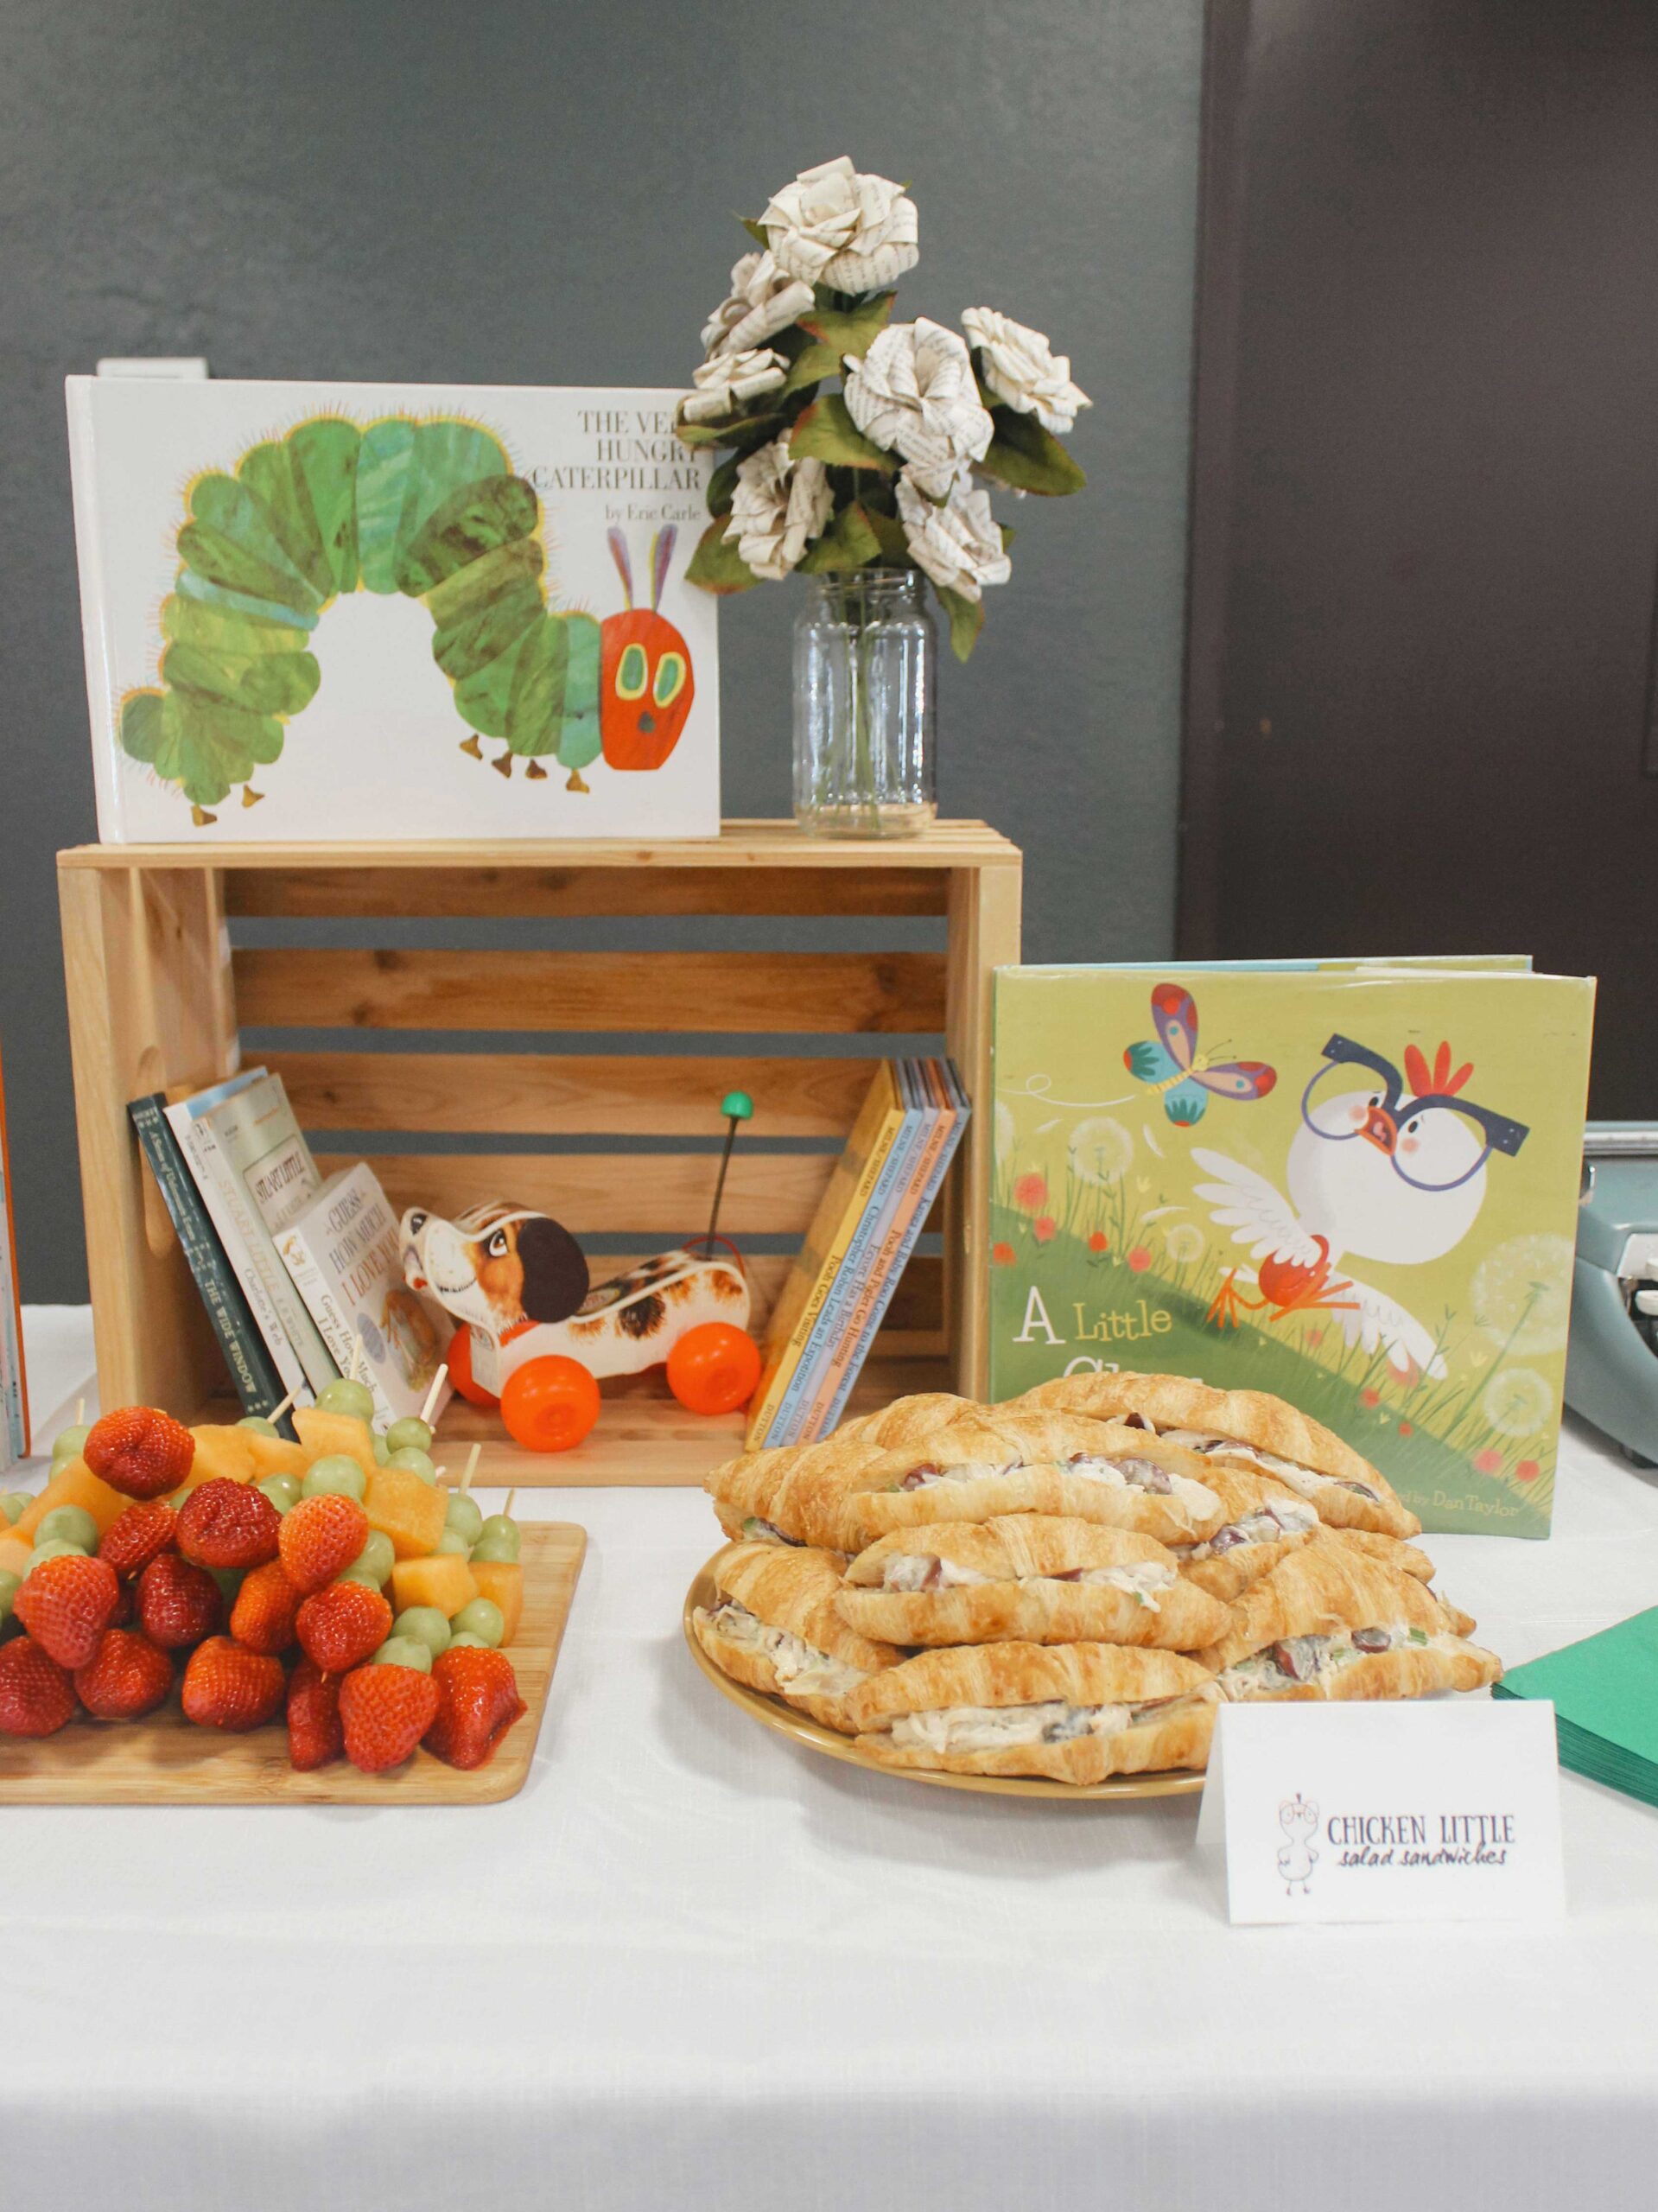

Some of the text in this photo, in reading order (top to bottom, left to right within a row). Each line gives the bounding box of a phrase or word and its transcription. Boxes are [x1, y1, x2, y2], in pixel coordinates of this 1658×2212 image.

[578, 410, 677, 434] THE VE
[532, 466, 702, 490] CATERPILLAR
[606, 504, 701, 524] by Eric Carle
[255, 1151, 306, 1205] STUART LITTLE
[910, 1196, 931, 1228] Kanga
[218, 1179, 256, 1239] STUART
[247, 1242, 280, 1294] LITTLE
[328, 1202, 387, 1274] HOW MUCH
[848, 1205, 880, 1263] Christopher
[882, 1230, 903, 1256] Pooh
[901, 1230, 914, 1249] and
[823, 1255, 842, 1281] Pooh
[857, 1244, 881, 1277] Eeyore
[873, 1258, 886, 1278] and
[891, 1249, 908, 1274] Baby
[341, 1281, 356, 1306] I
[350, 1249, 386, 1298] LOVE
[834, 1266, 854, 1294] Robin
[849, 1280, 865, 1299] Has
[879, 1276, 896, 1296] Roo
[810, 1284, 829, 1308] Goes
[862, 1280, 880, 1307] Piglet
[321, 1294, 340, 1329] Guess
[821, 1297, 841, 1326] Leads
[853, 1309, 867, 1324] Go
[865, 1300, 886, 1330] Come
[1012, 1286, 1172, 1344] A Little
[204, 1278, 257, 1393] THE WIDE WINDOW
[269, 1320, 282, 1346] Web
[792, 1311, 817, 1348] Visiting
[815, 1327, 825, 1340] an
[826, 1308, 853, 1350] Birthday
[322, 1325, 340, 1356] Love
[339, 1356, 352, 1379] Yo
[831, 1326, 860, 1368] Hunting
[853, 1343, 867, 1359] the
[791, 1341, 823, 1392] Expotition
[837, 1361, 859, 1392] Forest
[753, 1404, 775, 1441] DUTTON
[772, 1402, 792, 1440] DUTTON
[788, 1400, 810, 1438] DUTTON
[803, 1402, 824, 1440] DUTTON
[1432, 1491, 1464, 1510] Dan
[1465, 1495, 1519, 1516] Taylor
[1326, 1815, 1515, 1845] CHICKEN LITTLE
[1338, 1840, 1507, 1866] salad sandwiches
